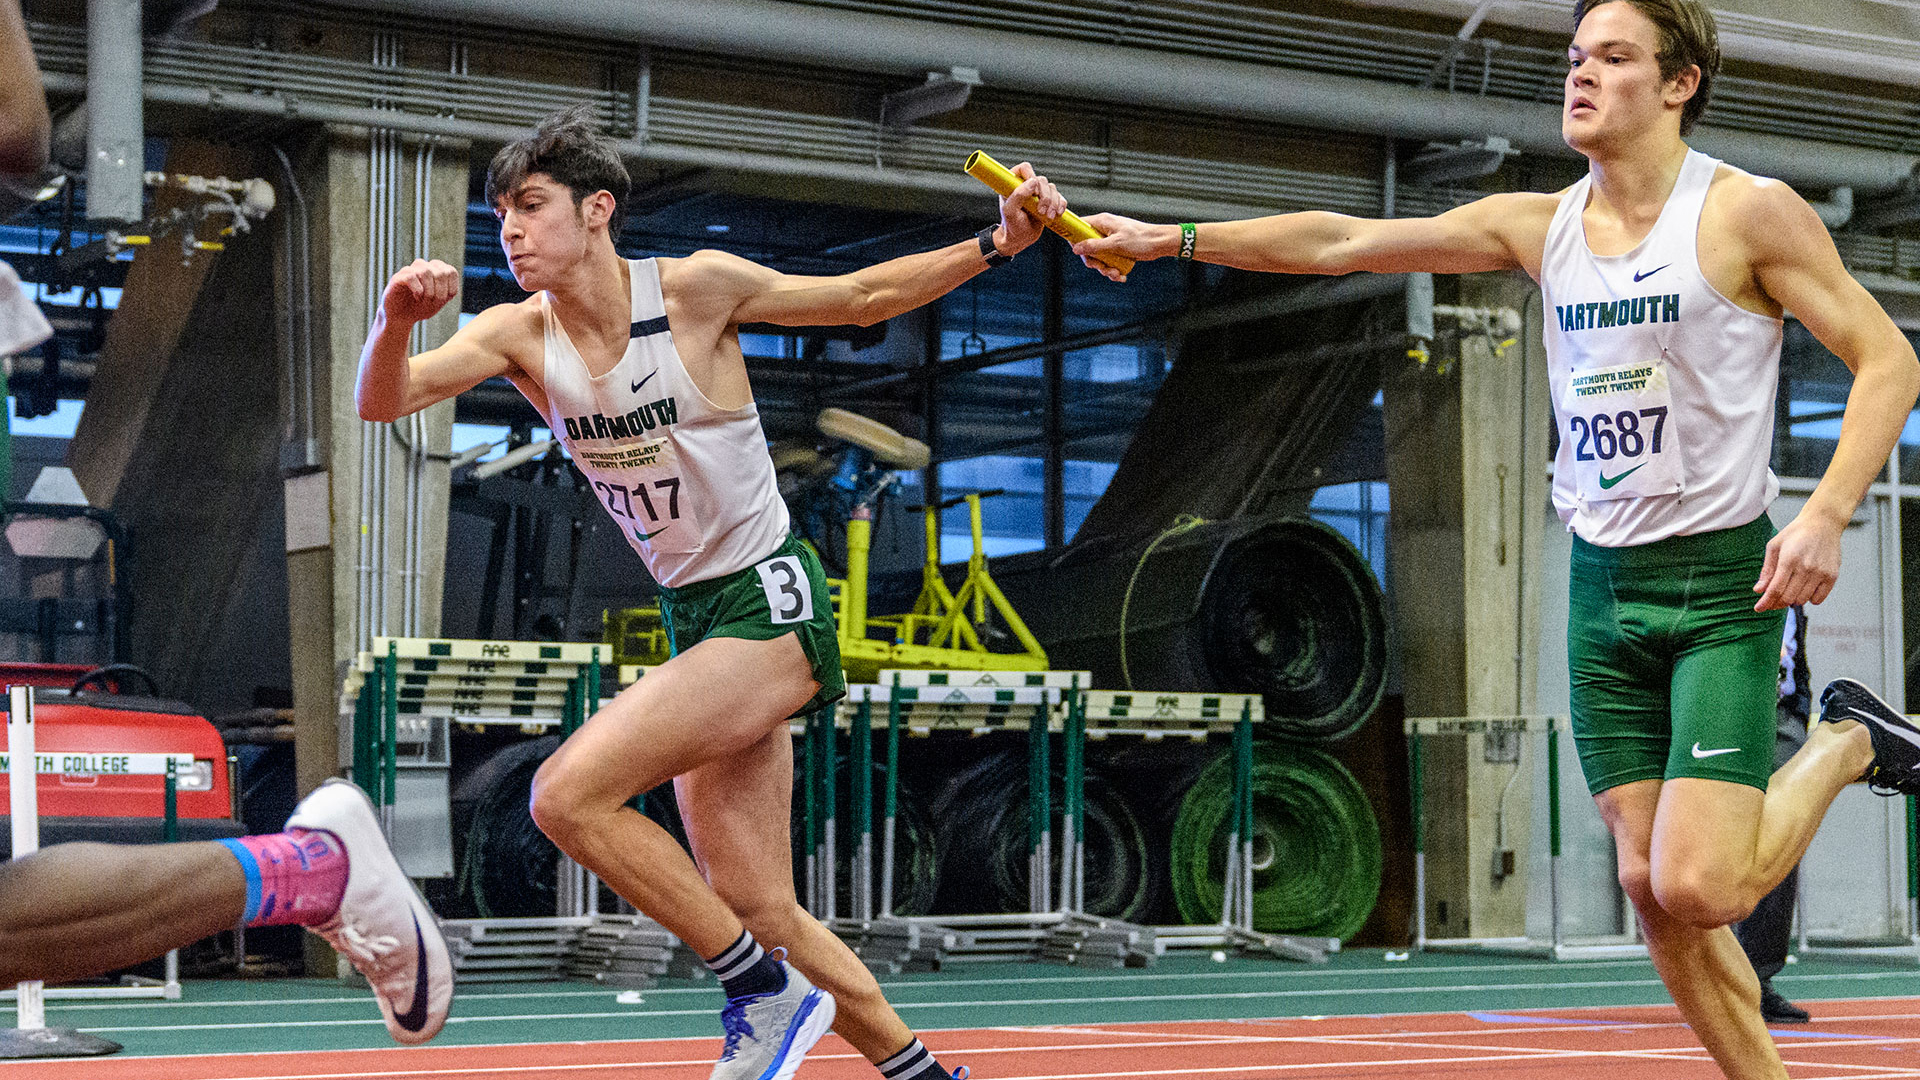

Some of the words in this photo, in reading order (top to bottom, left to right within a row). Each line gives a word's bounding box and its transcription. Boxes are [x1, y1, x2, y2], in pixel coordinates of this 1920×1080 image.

[1181, 230, 1195, 258] DXC
[1556, 294, 1680, 332] DARTMOUTH
[1572, 372, 1616, 387] DARTMOUTH
[1617, 367, 1653, 381] RELAYS
[1576, 384, 1608, 397] TWENTY
[1609, 379, 1647, 393] TWENTY
[1570, 405, 1669, 462] 2687
[580, 450, 625, 461] DARTMOUTH
[626, 444, 661, 458] RELAYS
[589, 460, 619, 469] TWENTY
[620, 455, 657, 469] TWENTY
[594, 477, 681, 522] 2717
[768, 560, 804, 620] 3
[63, 755, 130, 773] COLLEGE
